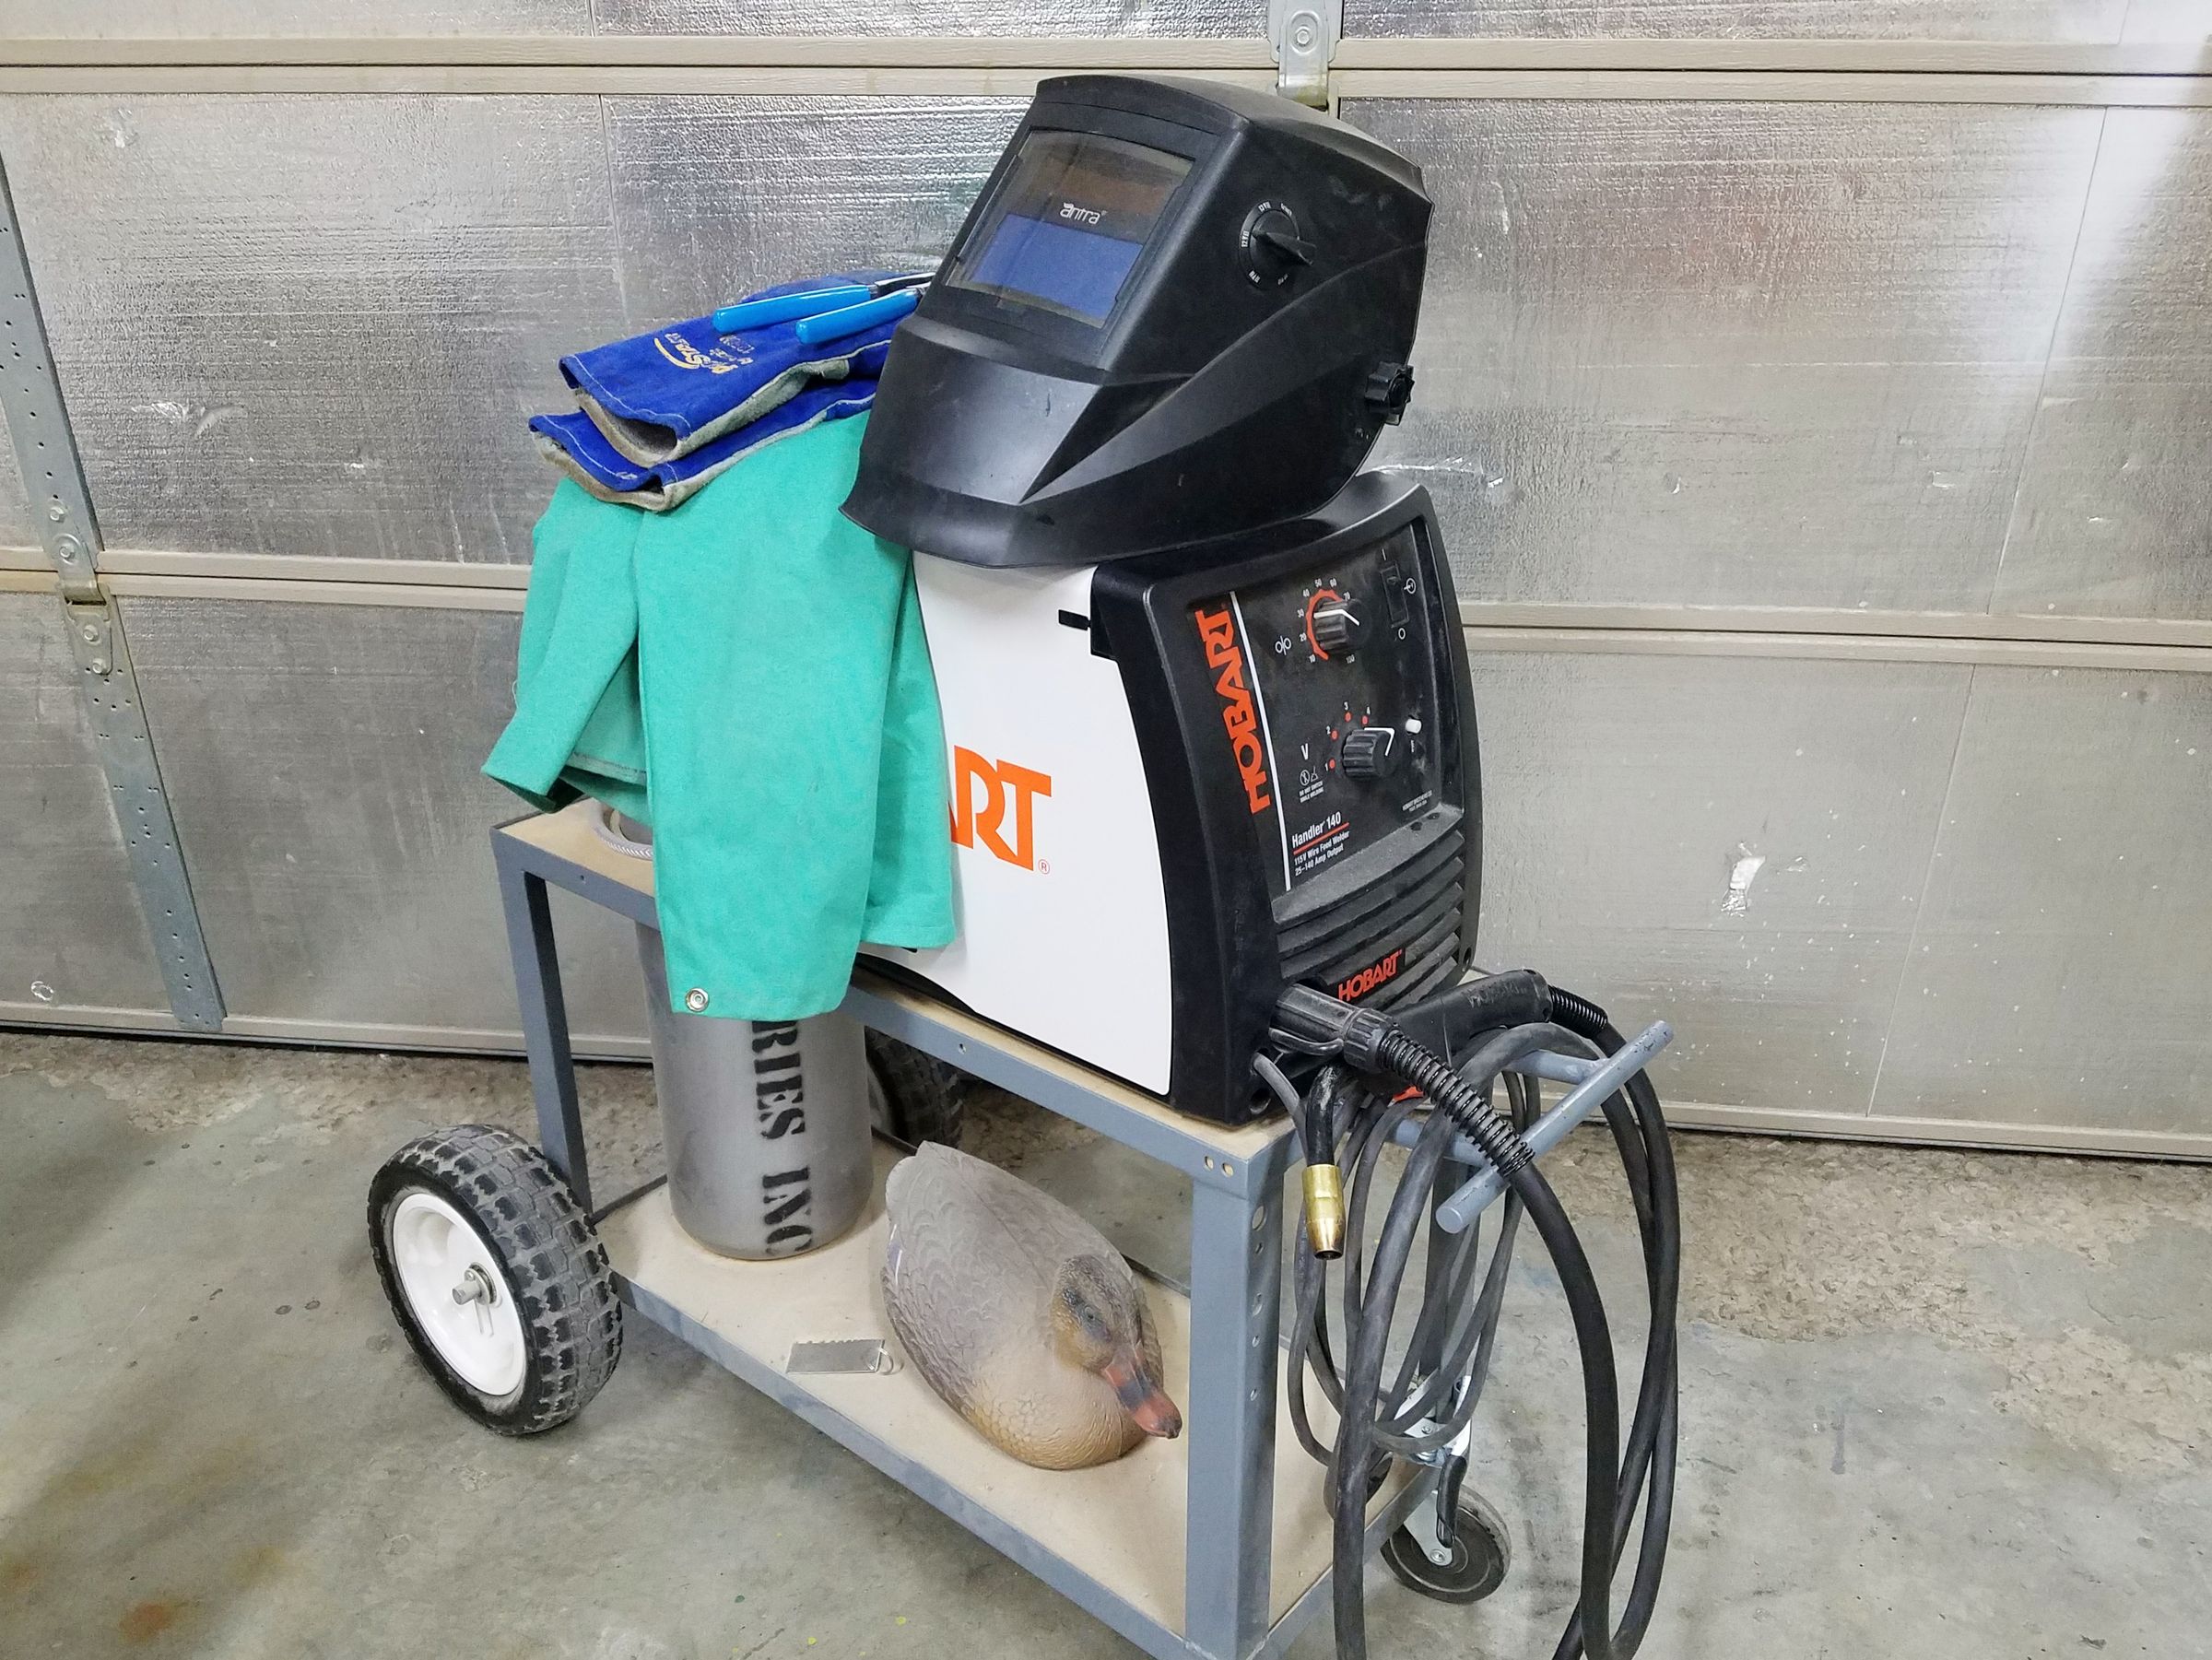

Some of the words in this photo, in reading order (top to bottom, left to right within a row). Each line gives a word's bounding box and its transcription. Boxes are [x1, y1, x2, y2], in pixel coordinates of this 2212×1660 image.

[1194, 609, 1271, 815] HOBART
[1300, 743, 1309, 760] V
[947, 745, 1052, 872] RT
[1291, 823, 1324, 849] Handler
[1326, 811, 1342, 830] 140
[1294, 853, 1307, 865] 115V
[1307, 847, 1320, 858] Wire
[1320, 839, 1332, 852] Feed
[1332, 830, 1350, 845] Welder
[1314, 854, 1326, 865] Amp
[1327, 842, 1344, 858] Output
[1338, 950, 1400, 1003] HOBART
